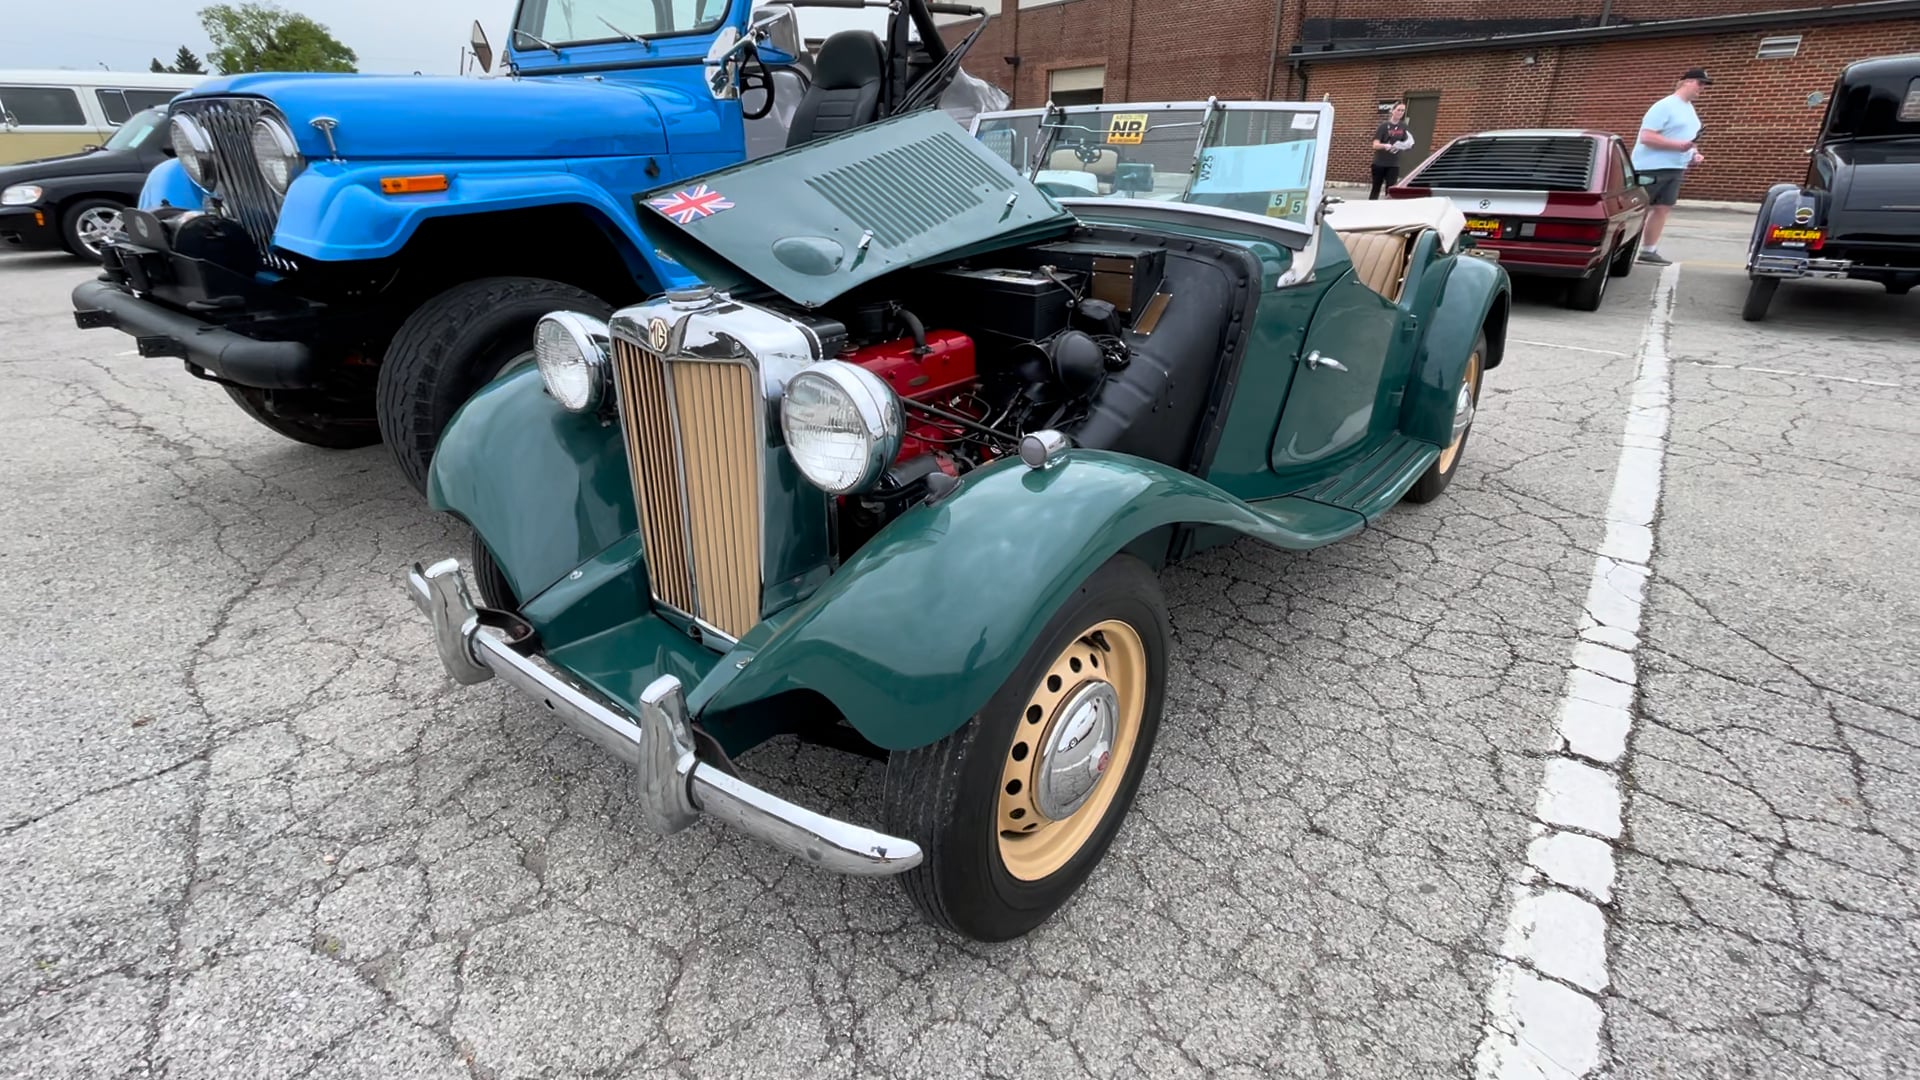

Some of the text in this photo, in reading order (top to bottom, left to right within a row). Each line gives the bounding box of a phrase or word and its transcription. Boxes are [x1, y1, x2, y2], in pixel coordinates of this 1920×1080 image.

[1110, 120, 1142, 138] NR
[1200, 155, 1214, 182] W25
[1274, 194, 1283, 207] 5
[1292, 201, 1301, 214] 5
[1772, 229, 1821, 239] MECUM
[650, 320, 667, 350] MG
